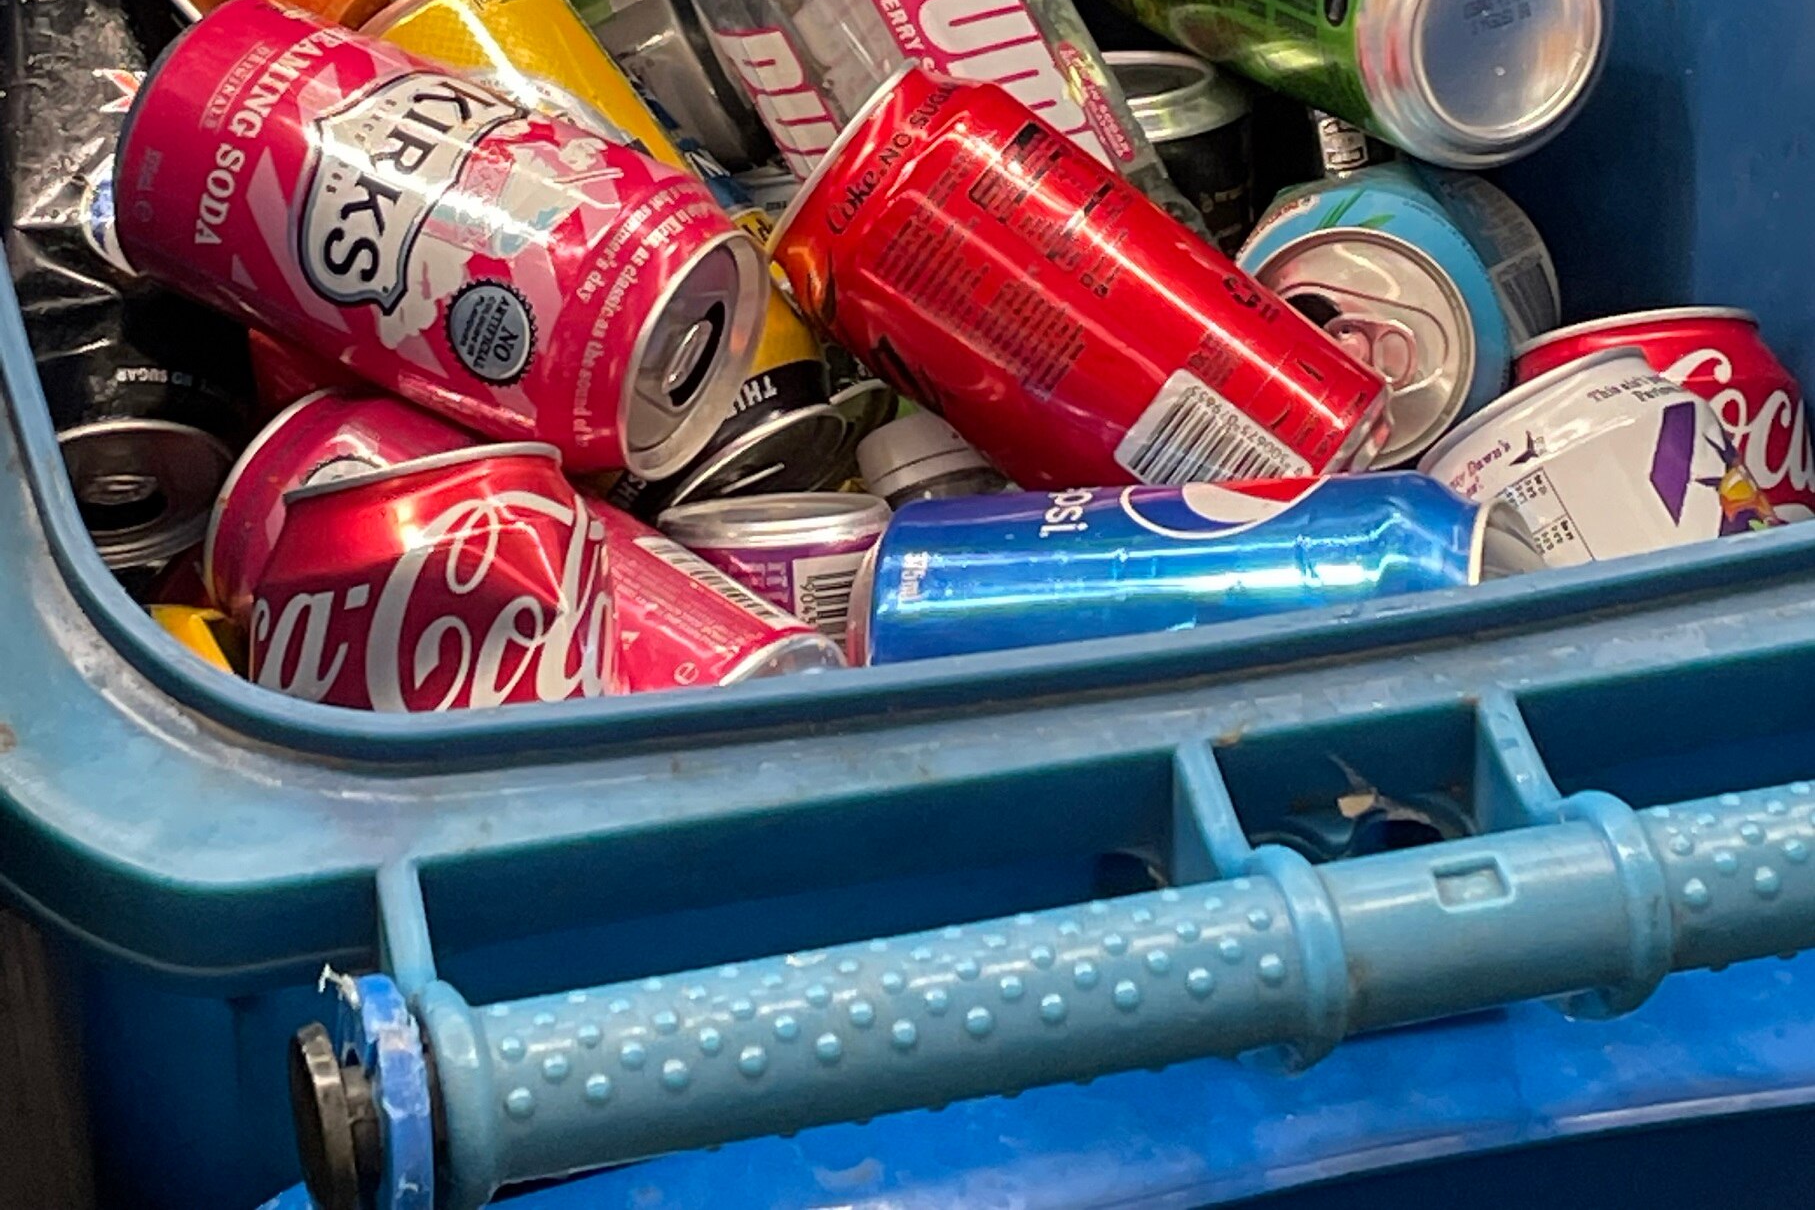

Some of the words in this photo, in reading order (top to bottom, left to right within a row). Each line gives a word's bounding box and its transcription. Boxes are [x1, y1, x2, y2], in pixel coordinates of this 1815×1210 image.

[227, 25, 349, 137] EAMING
[879, 131, 913, 176] NO
[195, 143, 243, 245] SODA
[322, 79, 498, 285] KIRKS
[629, 245, 650, 266] as
[575, 270, 605, 303] day
[600, 264, 638, 318] classic
[492, 325, 518, 360] NO
[581, 339, 604, 369] the
[115, 366, 168, 383] SUGAR
[572, 367, 592, 415] sound
